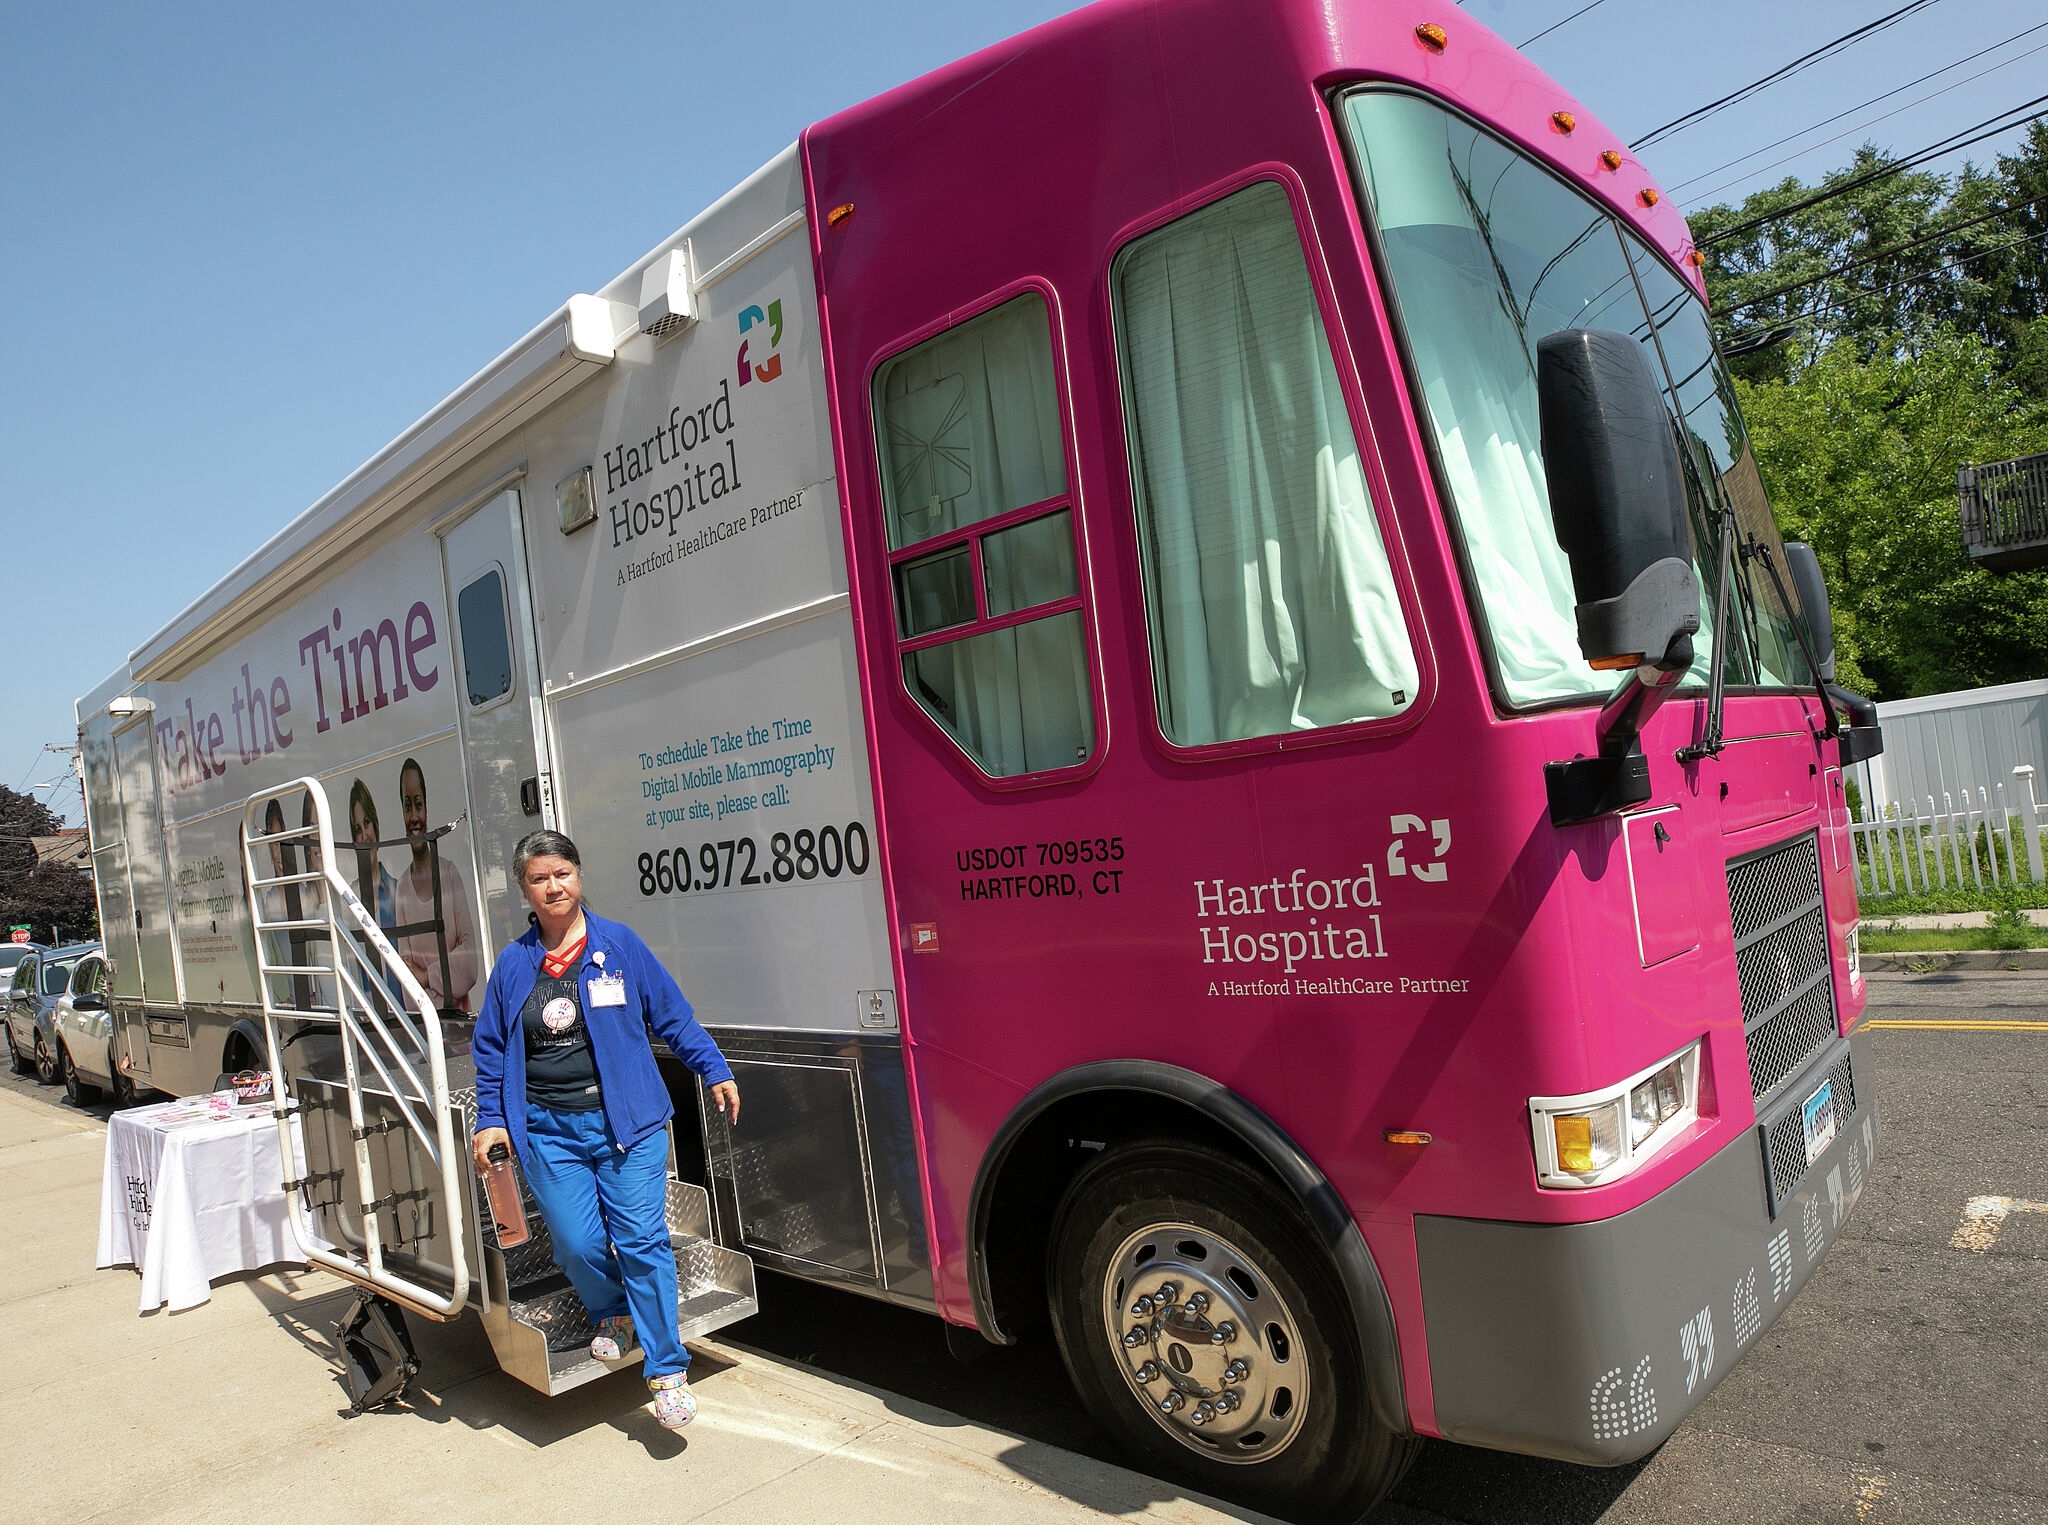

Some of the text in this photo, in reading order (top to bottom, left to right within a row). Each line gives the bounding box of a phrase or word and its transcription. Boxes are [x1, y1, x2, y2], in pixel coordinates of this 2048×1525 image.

[604, 378, 735, 495] Hartford
[609, 439, 741, 548] Hospital
[617, 490, 804, 586] A Hartford HealthCare Partner
[155, 601, 439, 795] Take the Time
[639, 718, 812, 770] To schedule Take the Time
[642, 743, 835, 801] Digital Mobile Mammography
[646, 784, 790, 830] at your site, please call:
[174, 855, 224, 893] Digital Mobile
[637, 821, 870, 897] 860.972.8800
[957, 837, 1125, 872] USDOT 709535
[177, 888, 234, 920] Mammography
[960, 870, 1124, 900] HARTFORD, CT
[1194, 863, 1382, 917] Hartford
[1199, 914, 1389, 974] Hospital
[525, 983, 554, 1012] EW
[1207, 977, 1470, 996] A Hartford HealthCare Partner
